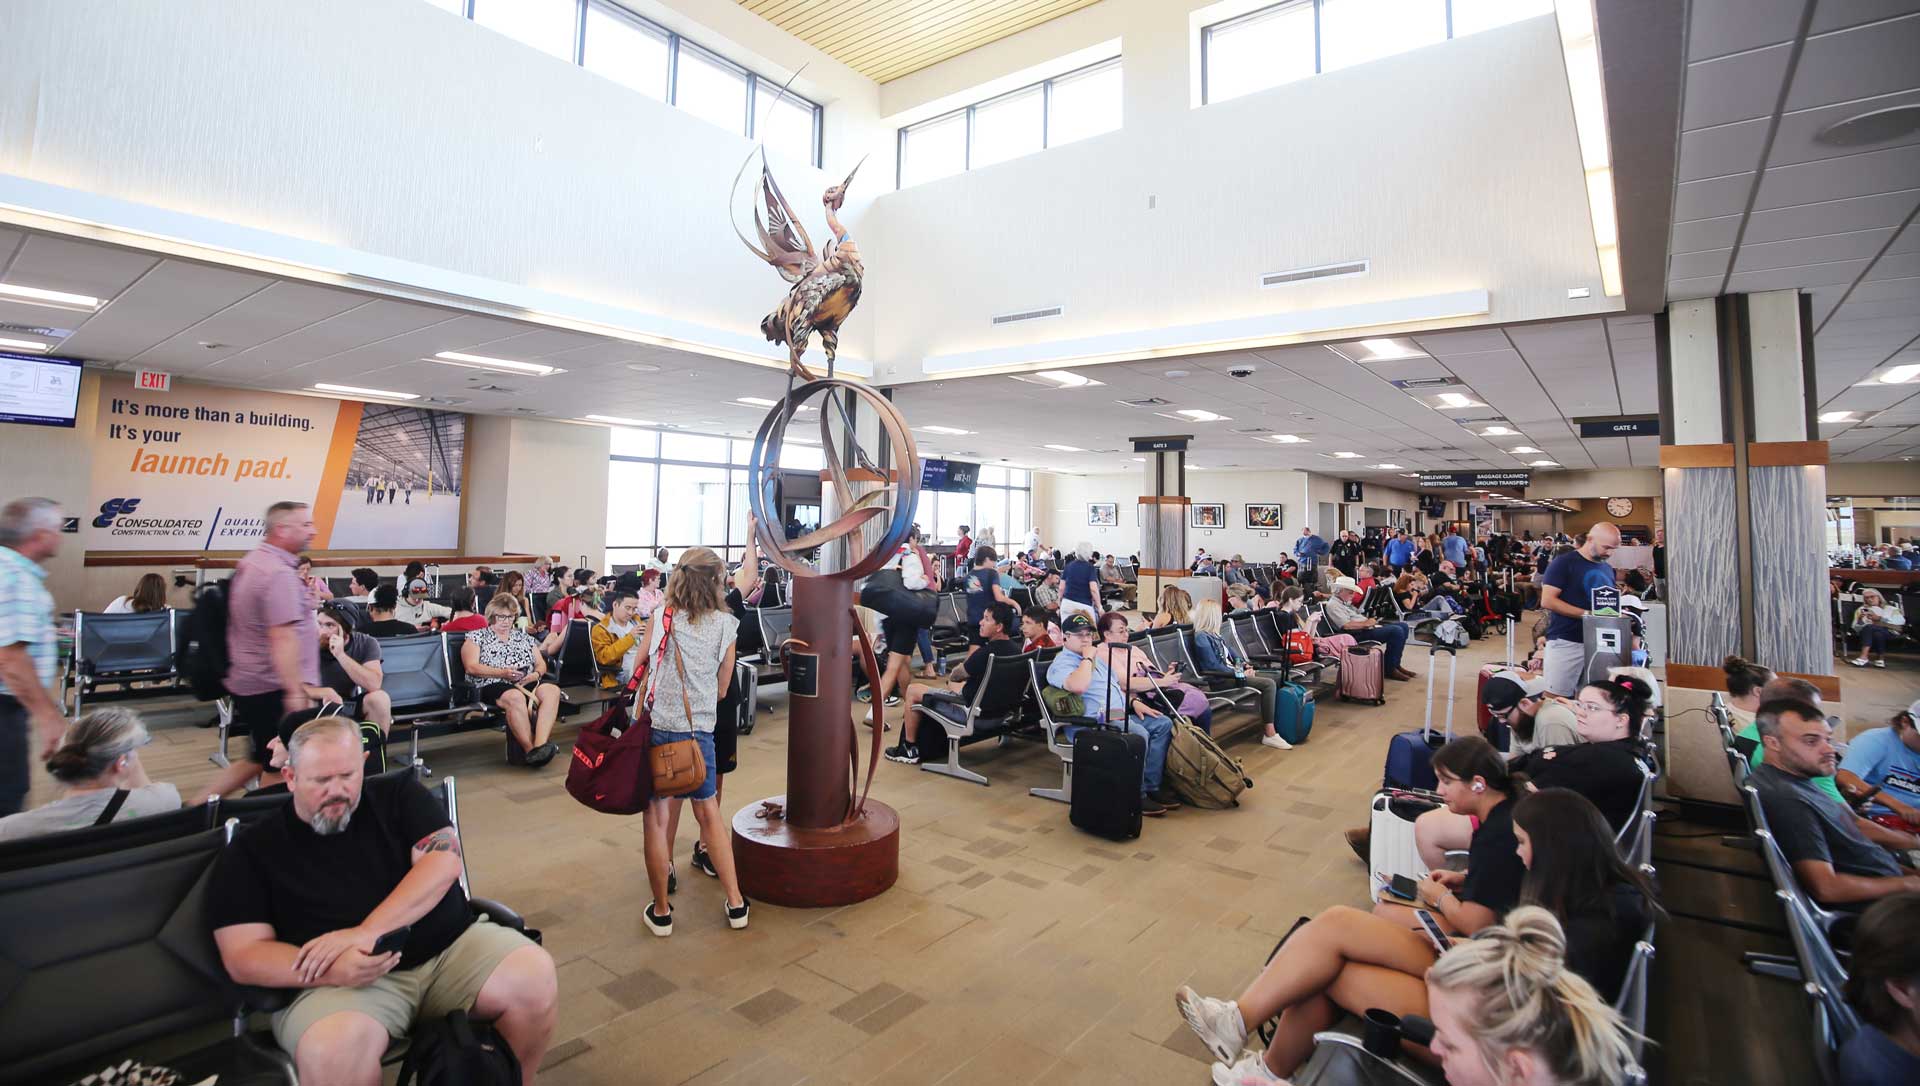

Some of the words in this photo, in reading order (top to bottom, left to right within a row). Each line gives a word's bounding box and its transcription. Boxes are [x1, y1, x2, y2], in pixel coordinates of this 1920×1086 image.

[141, 371, 167, 389] EXIT
[111, 398, 139, 416] It's
[145, 404, 190, 420] more
[194, 406, 230, 423] than
[235, 411, 244, 424] a
[250, 411, 315, 432] building.
[109, 423, 138, 440] It's
[143, 428, 181, 444] your
[130, 448, 230, 476] launch
[233, 456, 291, 482] pad.
[115, 517, 202, 528] CONSOLIDATED
[224, 518, 266, 526] QUALIT
[220, 528, 268, 536] EXPERIE
